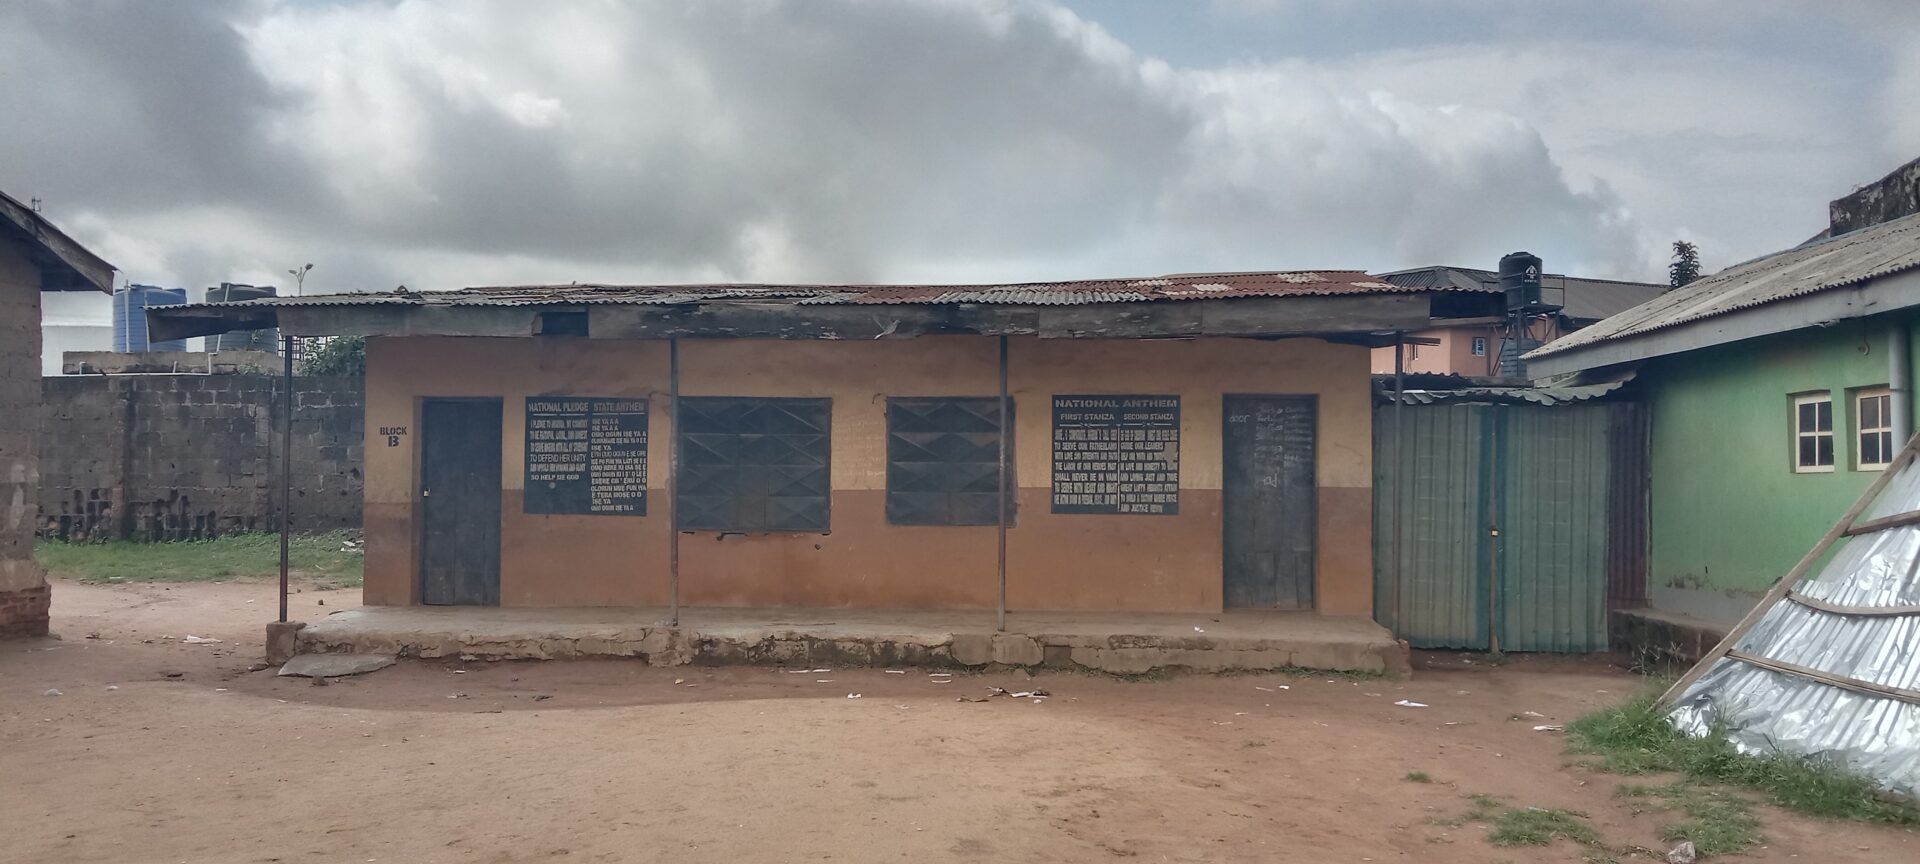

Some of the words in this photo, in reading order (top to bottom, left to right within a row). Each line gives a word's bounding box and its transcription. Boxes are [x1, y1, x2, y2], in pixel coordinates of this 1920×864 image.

[528, 402, 562, 412] NATIONAL
[593, 401, 615, 411] STATE
[1055, 399, 1120, 408] NATIONAL
[1122, 399, 1178, 408] ANTHEM
[1060, 413, 1083, 421] FIRST
[1084, 413, 1115, 421] STANZA
[1123, 413, 1149, 421] SECOND
[1149, 413, 1175, 421] STANZA
[379, 426, 408, 435] BLOCK
[388, 435, 400, 447] B
[1054, 442, 1061, 451] TO
[1062, 442, 1077, 451] SERVE
[1054, 473, 1070, 482] SHALL
[1071, 473, 1088, 482] NEVER
[1089, 473, 1097, 482] BE
